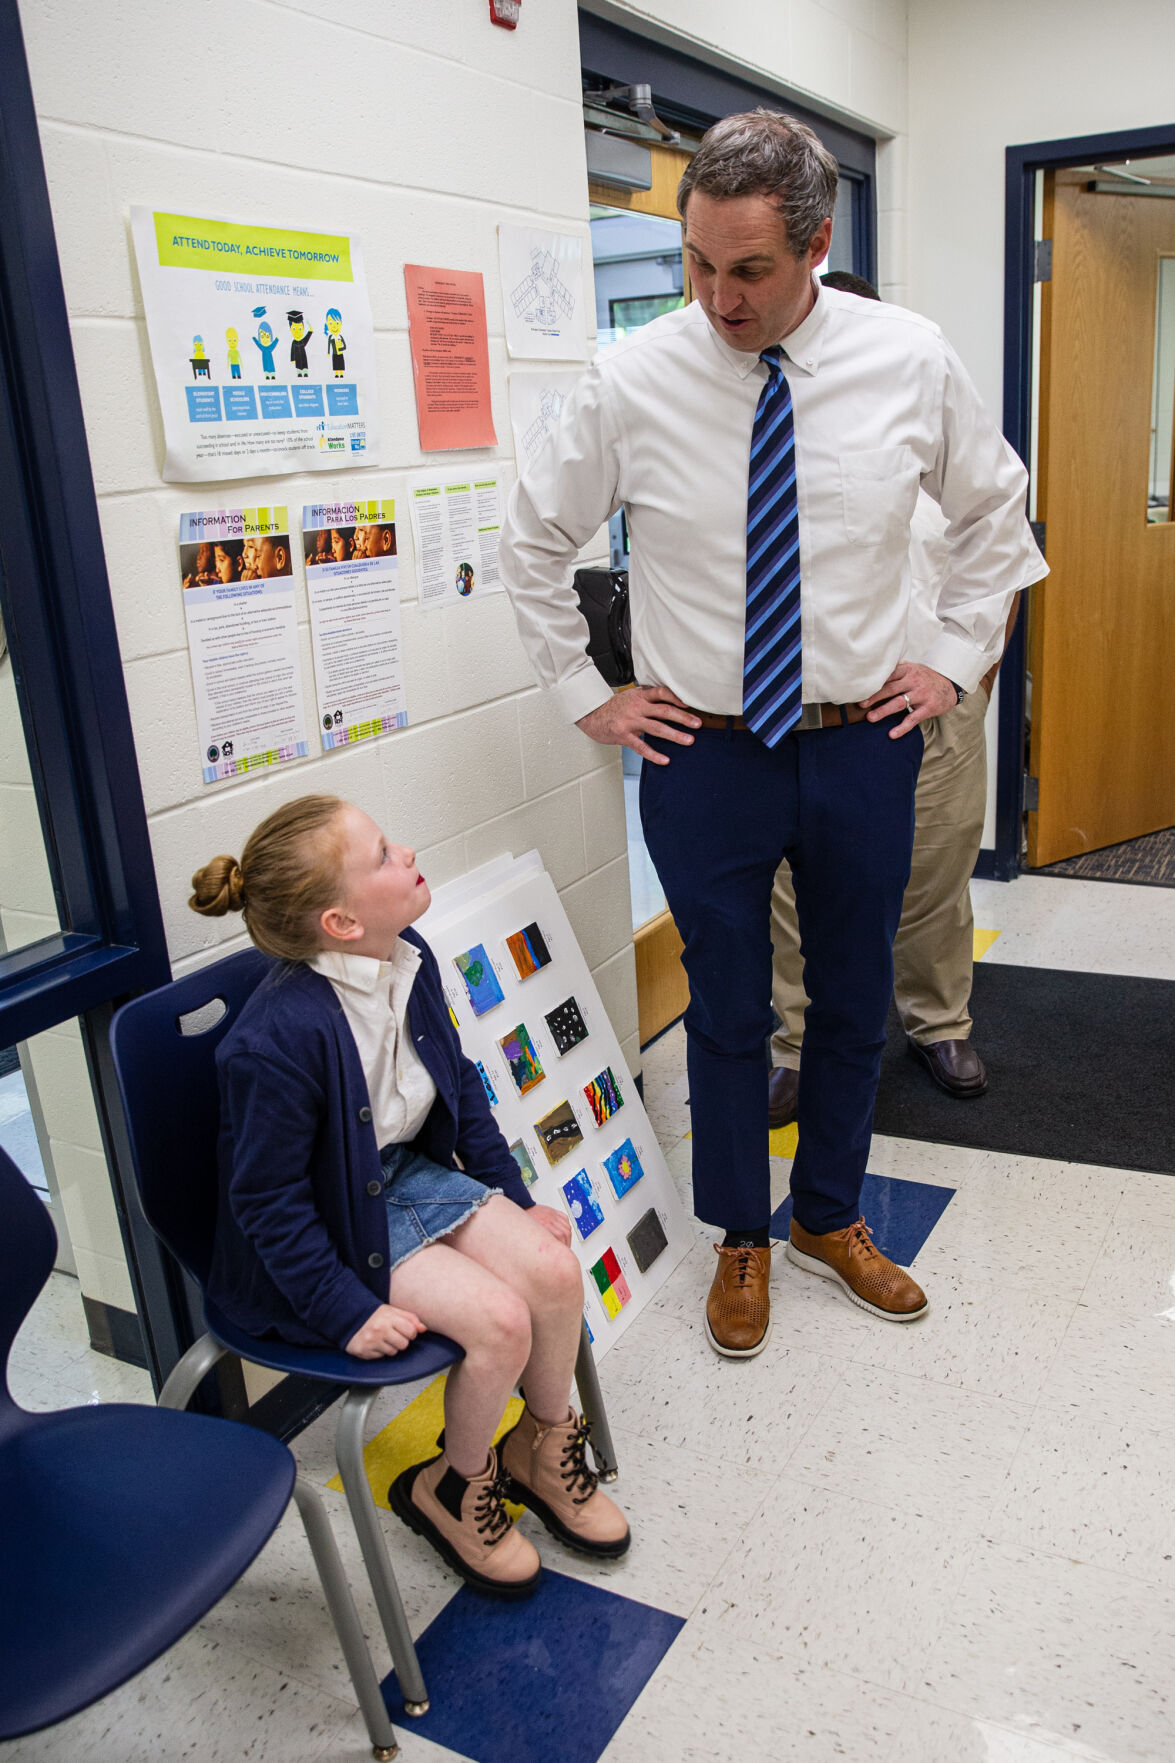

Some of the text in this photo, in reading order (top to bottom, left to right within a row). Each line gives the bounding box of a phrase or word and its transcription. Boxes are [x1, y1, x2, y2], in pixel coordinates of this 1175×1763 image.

[172, 235, 340, 263] ATTEND TODAY, ACHIEVE TOMORROW
[215, 280, 231, 291] GOOD
[233, 282, 254, 293] SCHOOL
[256, 284, 290, 296] ATTENDANCE
[311, 505, 360, 517] INFORMACIÓN
[189, 514, 246, 528] INFORMATION
[326, 515, 343, 524] PARA
[359, 512, 386, 521] PADRES
[244, 523, 280, 533] PARENTS
